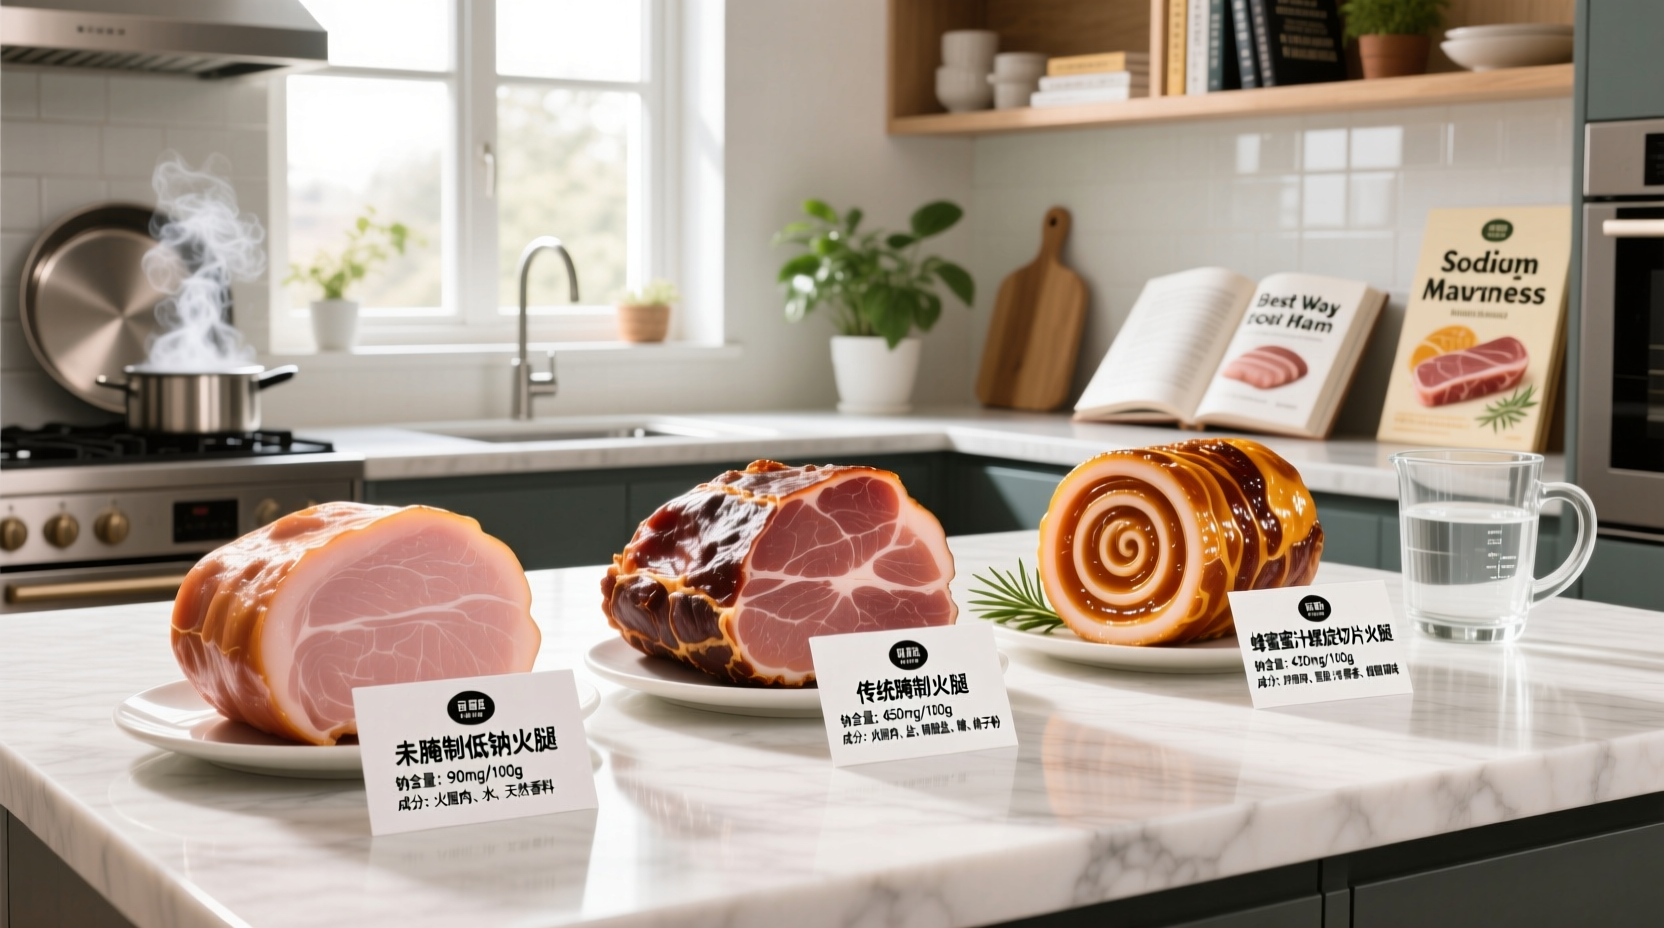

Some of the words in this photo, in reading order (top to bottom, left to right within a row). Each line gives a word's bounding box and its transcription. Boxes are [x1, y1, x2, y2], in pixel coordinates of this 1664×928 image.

[1441, 249, 1539, 275] Sodium
[1257, 293, 1297, 309] Best
[1303, 294, 1341, 319] Way
[1286, 314, 1333, 334] Ham
[856, 672, 970, 705] 传统腌制火腿
[395, 725, 559, 767] 未腌制低钠火腿
